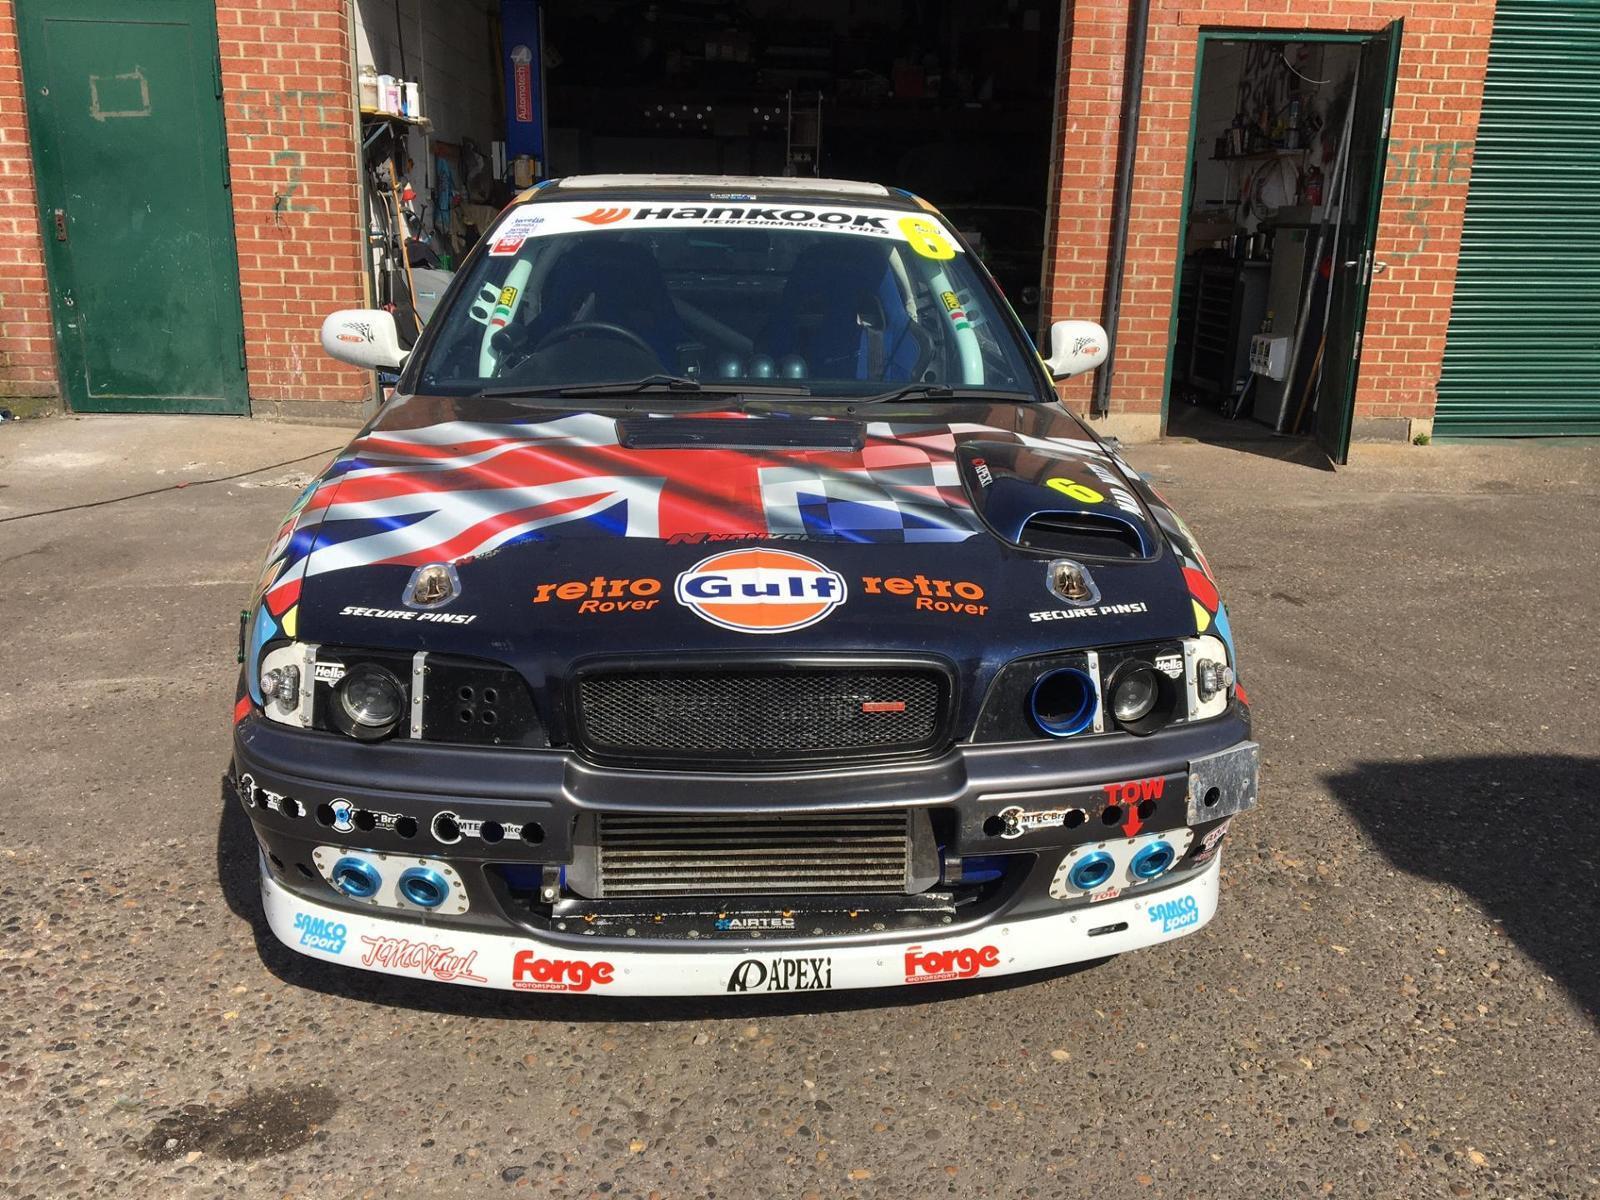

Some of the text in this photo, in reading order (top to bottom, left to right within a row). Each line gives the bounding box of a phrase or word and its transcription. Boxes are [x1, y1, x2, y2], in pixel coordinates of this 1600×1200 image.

[517, 65, 527, 120] Automotech
[702, 219, 890, 235] PERFORMANCE TYRES
[1046, 478, 1105, 504] 6
[533, 576, 662, 603] retro
[685, 575, 837, 599] Gulf
[862, 574, 985, 601] retro
[339, 606, 477, 625] SECURE PINS!
[578, 599, 660, 614] Rover
[916, 597, 989, 616] Rover
[1029, 602, 1149, 623] SECURE PINS!
[315, 665, 346, 679] Hella
[1155, 658, 1183, 671] Hella
[1104, 776, 1166, 806] TOW
[1094, 889, 1119, 901] TOW
[1147, 895, 1196, 922] SAMCO
[294, 912, 347, 938] SAMCO
[729, 918, 796, 926] AIRTEC
[514, 982, 566, 990] MOTORSPORT
[906, 972, 957, 983] MOTORSPORT
